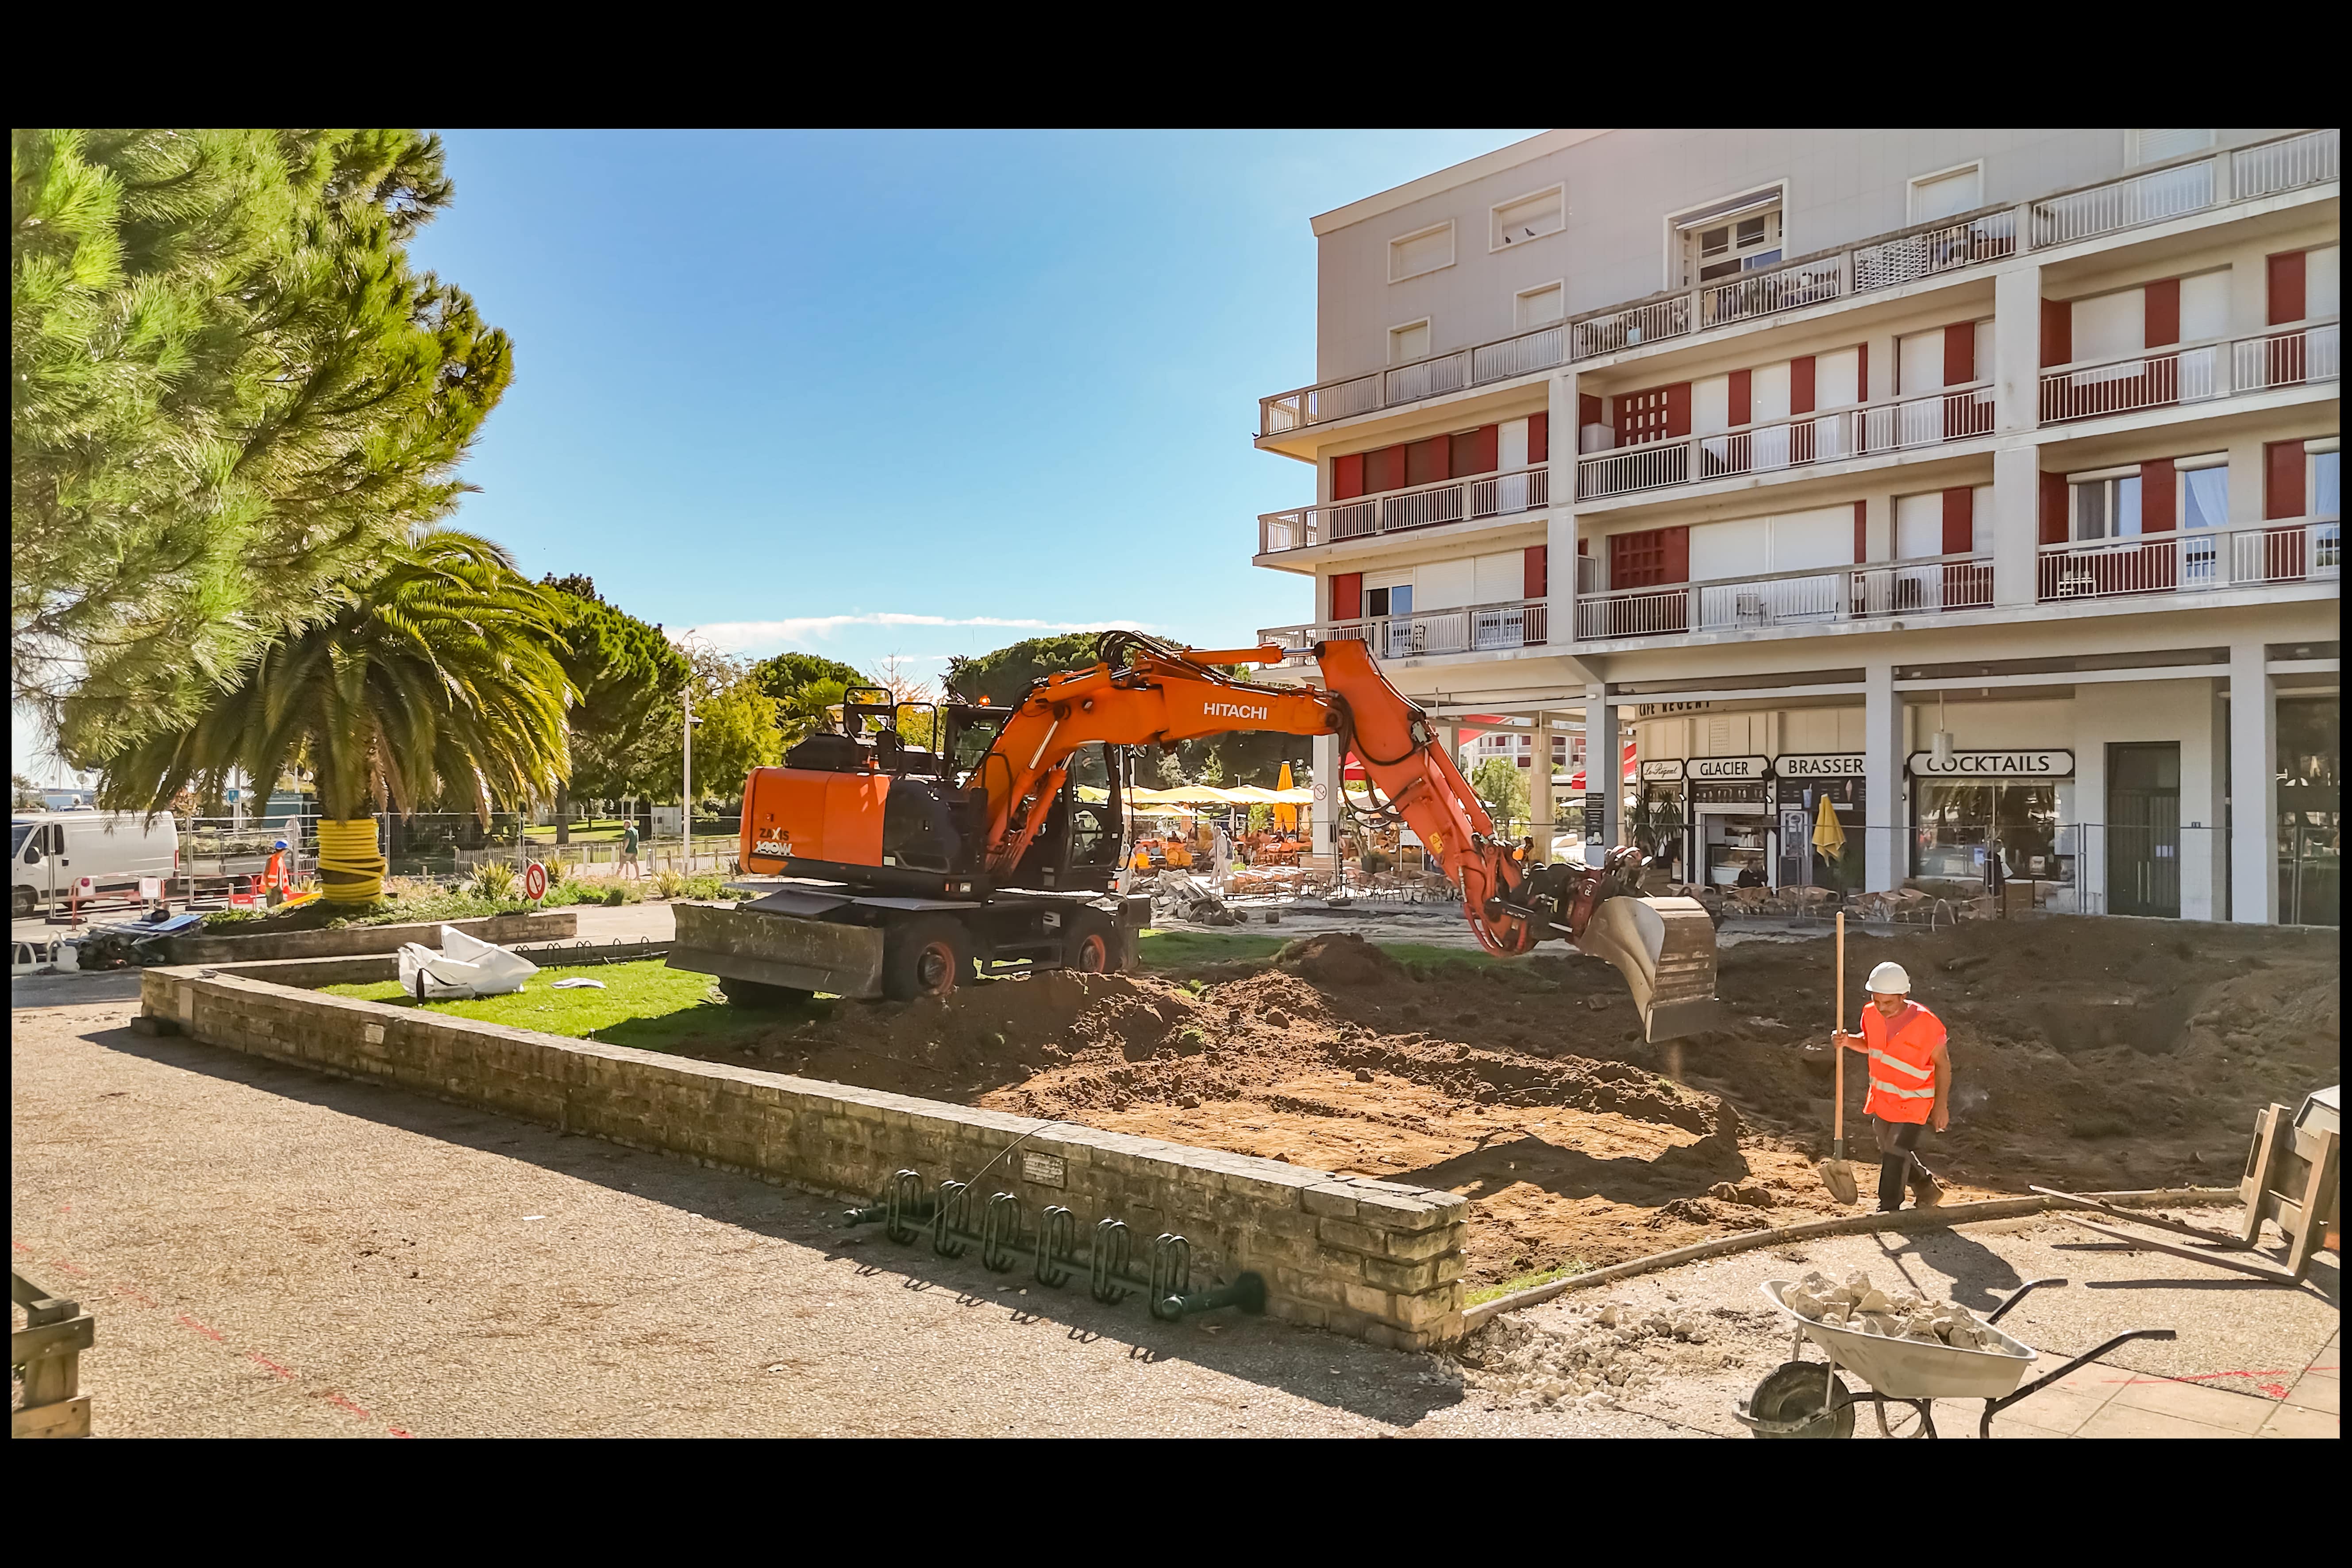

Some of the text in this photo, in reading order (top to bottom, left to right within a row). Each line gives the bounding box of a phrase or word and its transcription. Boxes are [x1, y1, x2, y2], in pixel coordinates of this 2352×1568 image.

[1204, 702, 1267, 720] HITACHI
[1700, 762, 1749, 775] GLACIER
[1926, 756, 2049, 772] COCKTAILS
[759, 827, 789, 841] ZAXIS
[755, 840, 793, 855] 140W
[1584, 884, 1593, 896] R4
